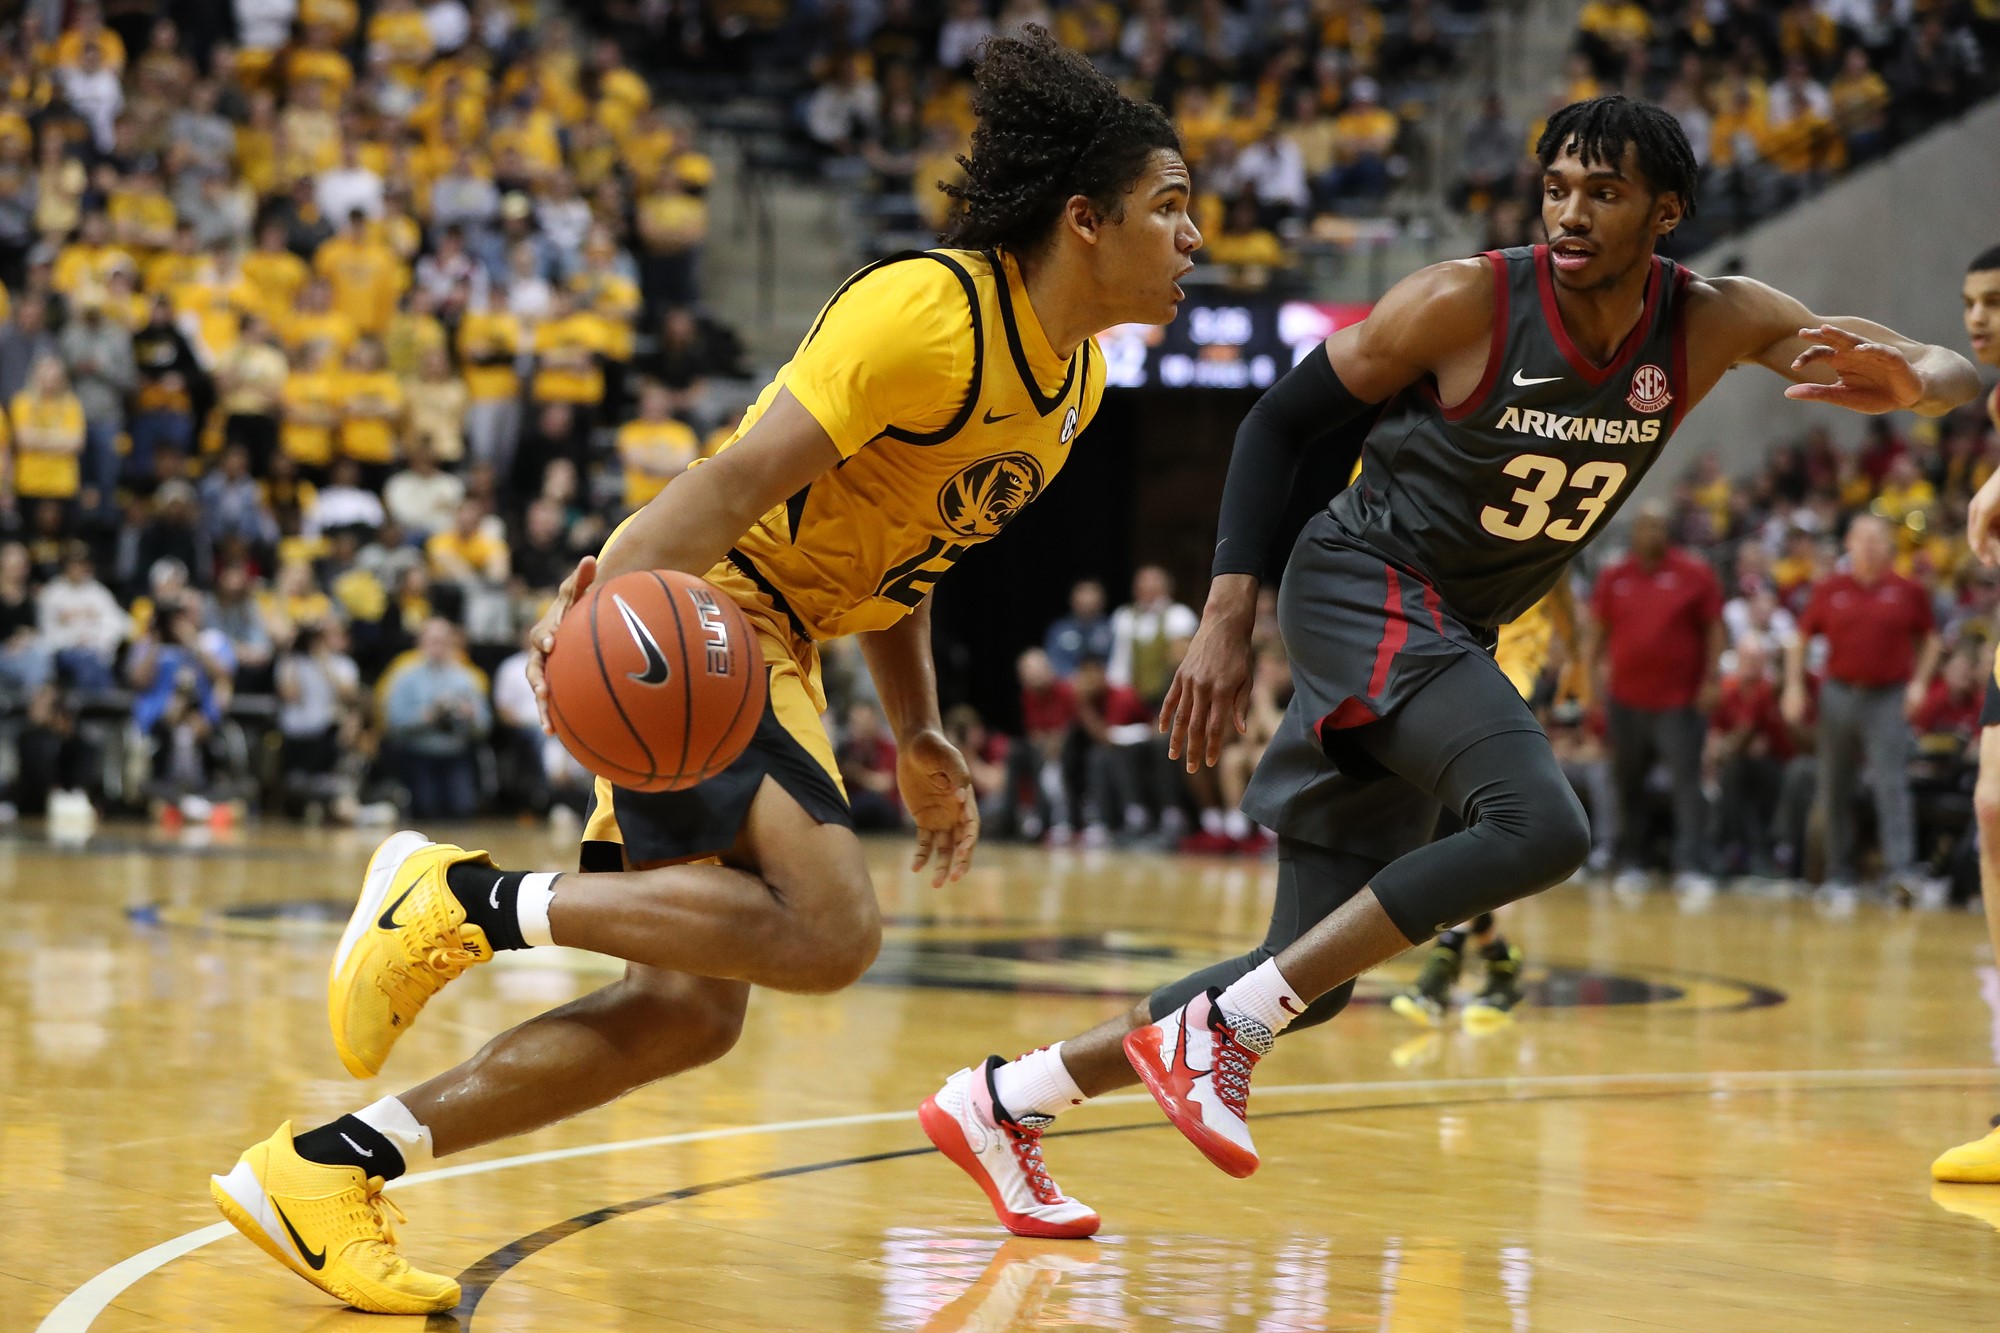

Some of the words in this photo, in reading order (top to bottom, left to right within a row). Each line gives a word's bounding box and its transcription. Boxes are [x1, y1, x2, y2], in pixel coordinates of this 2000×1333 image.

[1635, 367, 1663, 400] SEC
[1632, 400, 1666, 411] GRADUATE
[1495, 406, 1661, 444] ARKANSAS
[1480, 453, 1627, 542] 33
[686, 586, 728, 677] ELITE
[1236, 1031, 1264, 1054] YouTube
